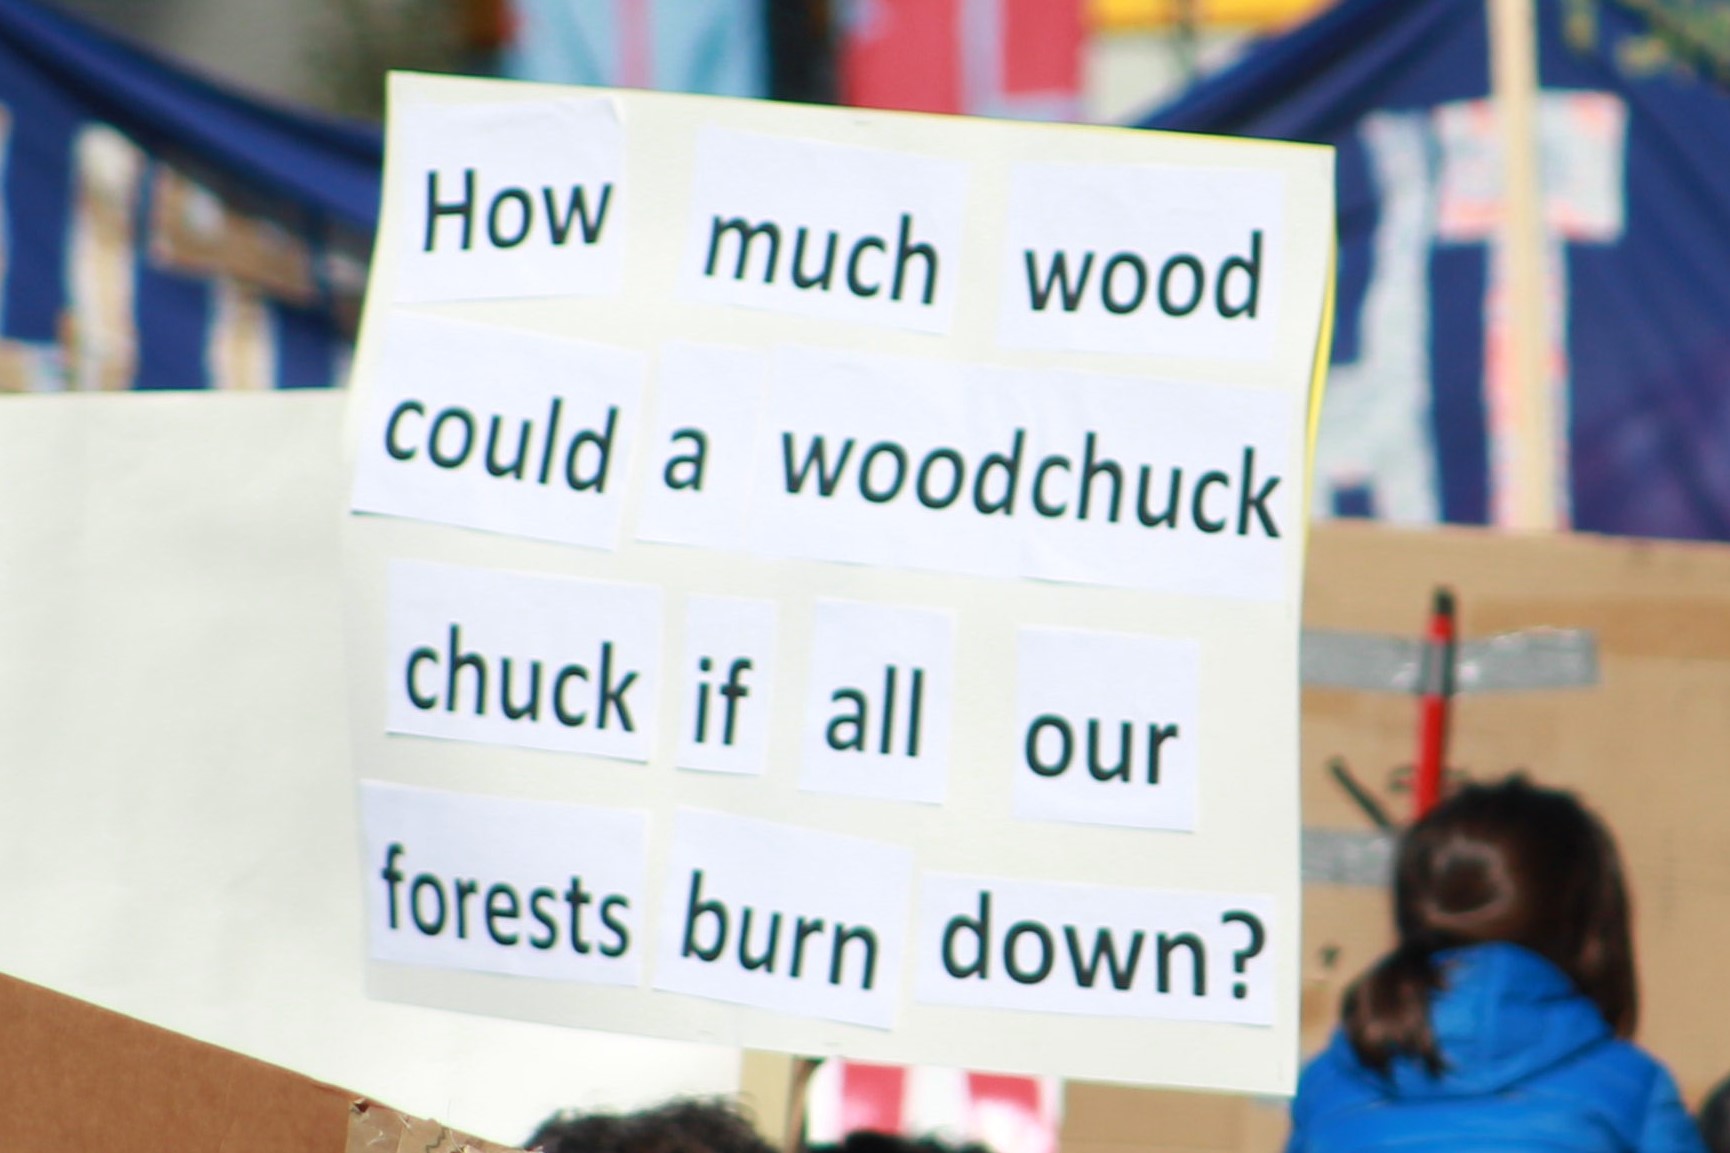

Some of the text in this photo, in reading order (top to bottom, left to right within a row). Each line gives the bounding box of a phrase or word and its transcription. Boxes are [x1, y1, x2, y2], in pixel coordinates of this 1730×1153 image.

[425, 170, 1262, 319] How much wood
[385, 398, 1281, 538] could a woodchuck
[406, 625, 1178, 785] chuck if all our
[382, 844, 1265, 1000] forests burn down?
